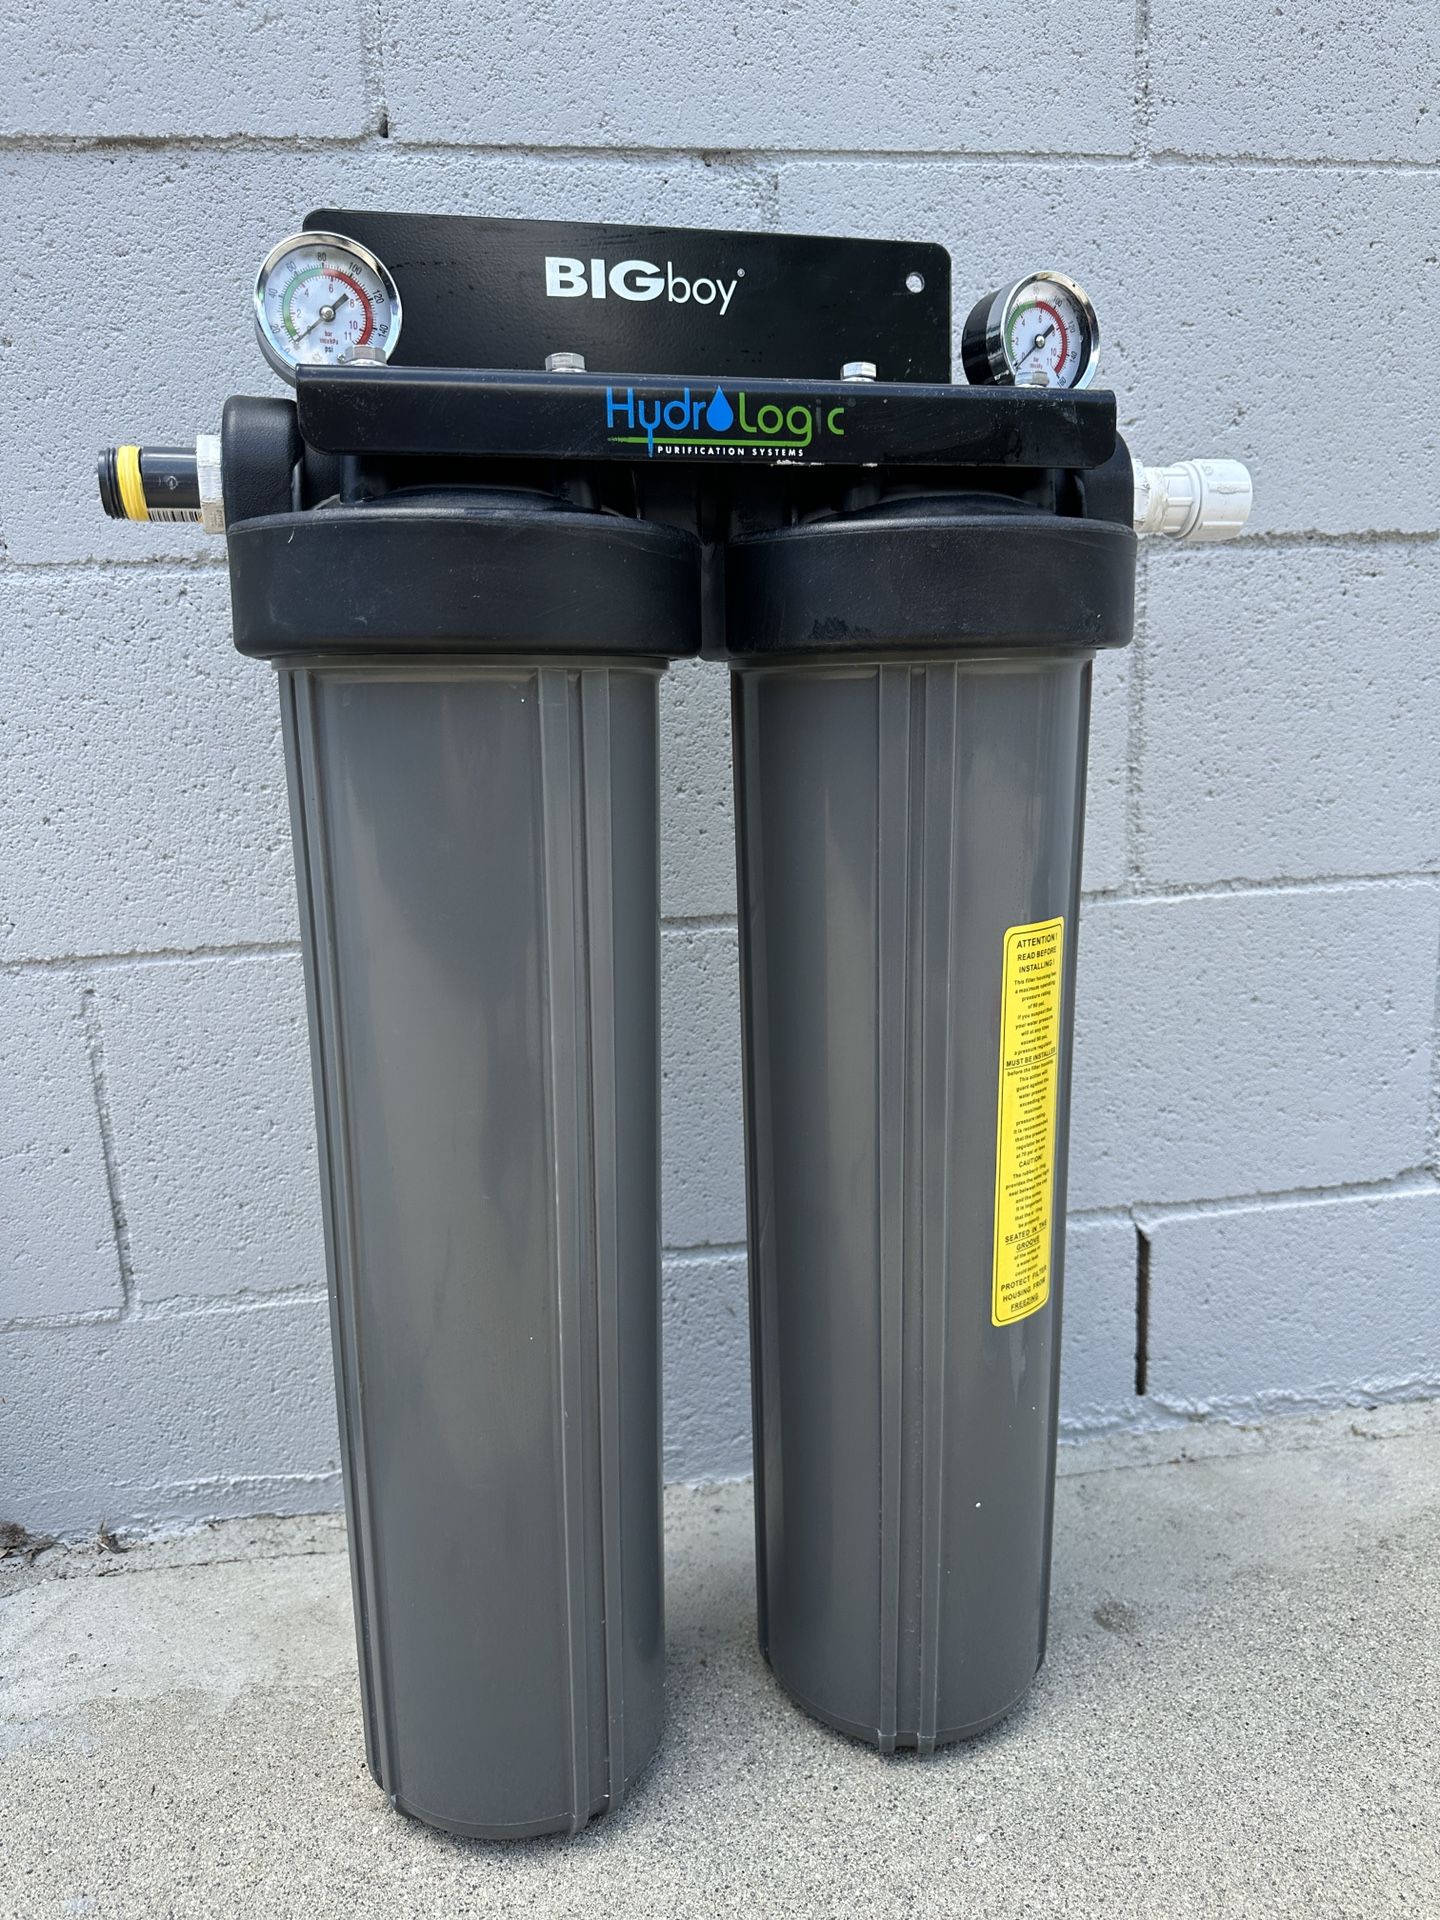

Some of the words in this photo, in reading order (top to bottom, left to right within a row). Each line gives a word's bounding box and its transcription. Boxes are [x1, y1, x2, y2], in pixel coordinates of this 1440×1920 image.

[317, 252, 326, 261] 80
[286, 262, 297, 272] 60
[349, 262, 362, 275] 100
[268, 288, 278, 298] 40
[304, 286, 309, 296] 4
[329, 284, 333, 293] 6
[372, 290, 385, 304] 120
[271, 324, 281, 334] 20
[349, 321, 357, 330] 10
[378, 324, 389, 338] 140
[1068, 320, 1076, 333] 120
[344, 331, 352, 340] 11
[1070, 351, 1078, 363] 140
[657, 445, 745, 456] PURIFICATION
[752, 447, 804, 457] SYSTEMS
[1017, 952, 1035, 961] READ
[1036, 946, 1056, 958] BEFORE
[1006, 1058, 1024, 1067] MUST
[1024, 1056, 1032, 1064] BE
[1005, 1228, 1030, 1242] SEATED
[1016, 1236, 1040, 1250] GROOVE
[1001, 1274, 1030, 1292] PROTECT
[1002, 1286, 1031, 1302] HOUSING
[1033, 1276, 1046, 1290] FROM
[1011, 1293, 1039, 1311] FREEZING
